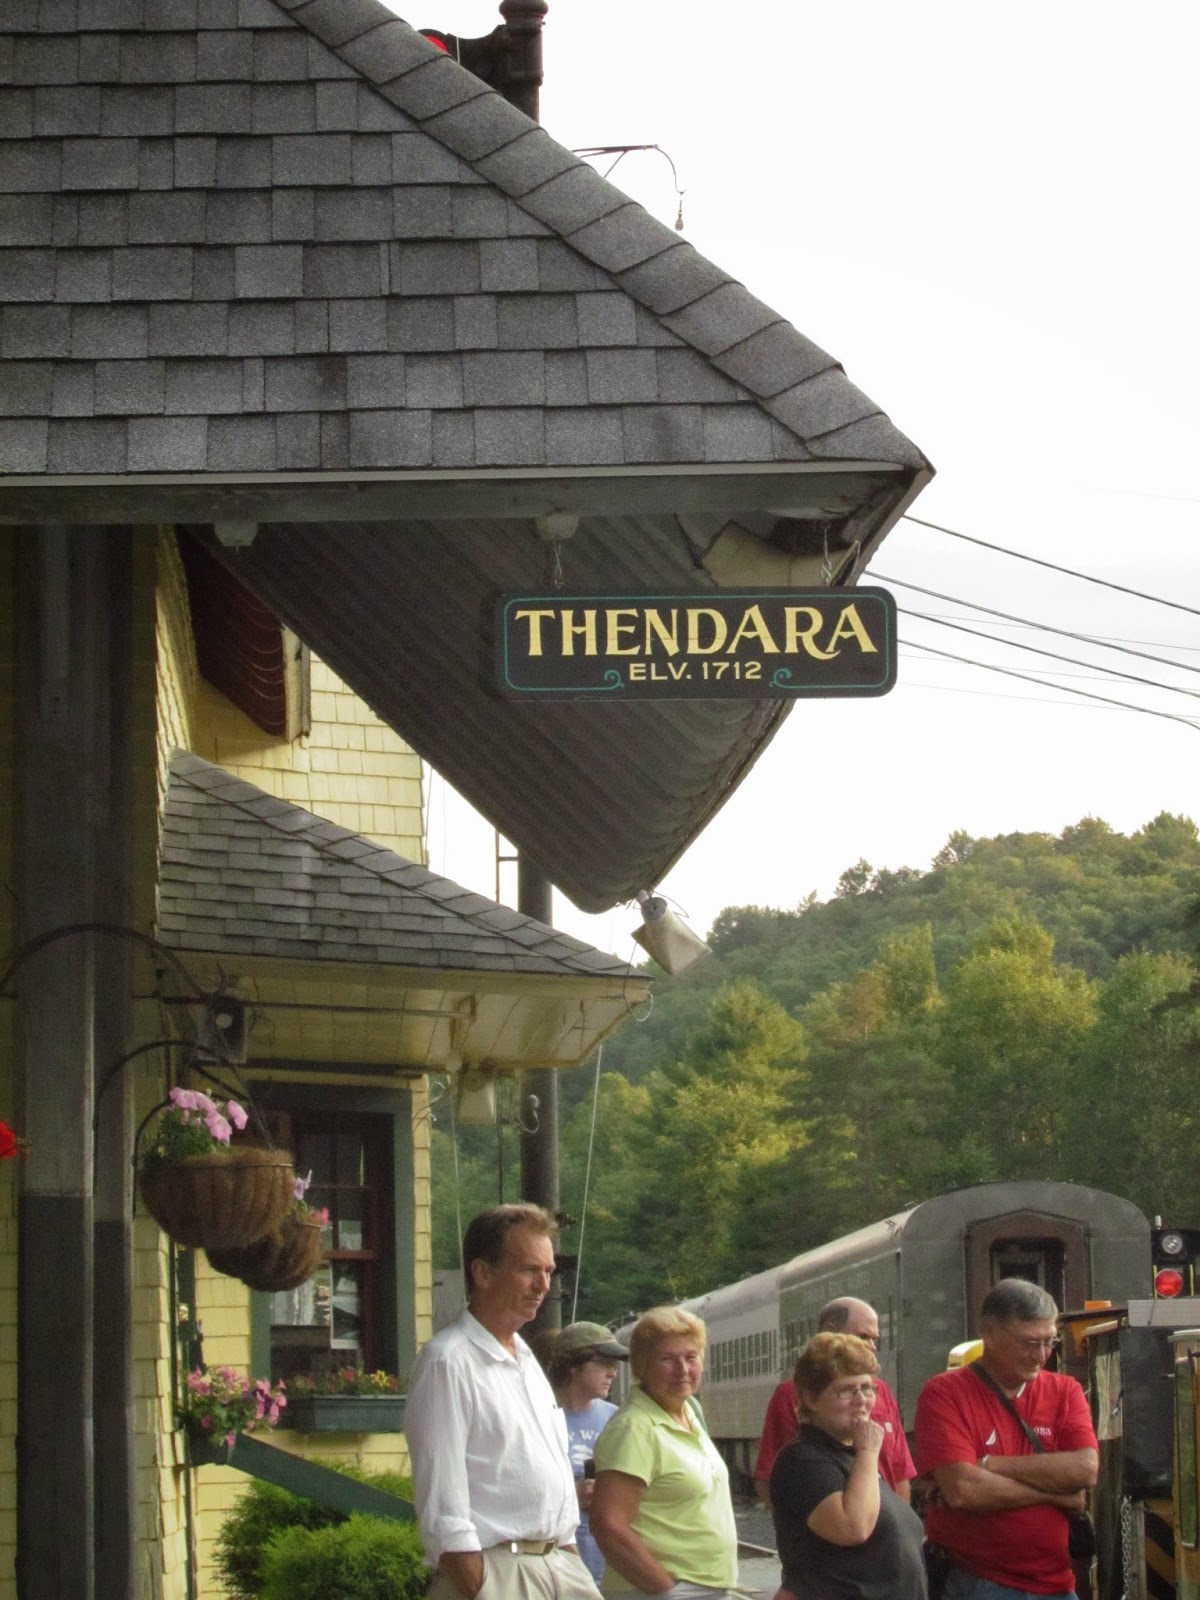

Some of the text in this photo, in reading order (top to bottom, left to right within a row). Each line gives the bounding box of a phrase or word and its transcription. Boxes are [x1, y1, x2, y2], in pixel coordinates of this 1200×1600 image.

[515, 603, 878, 660] THENDARA
[629, 661, 762, 681] ELV. 1712
